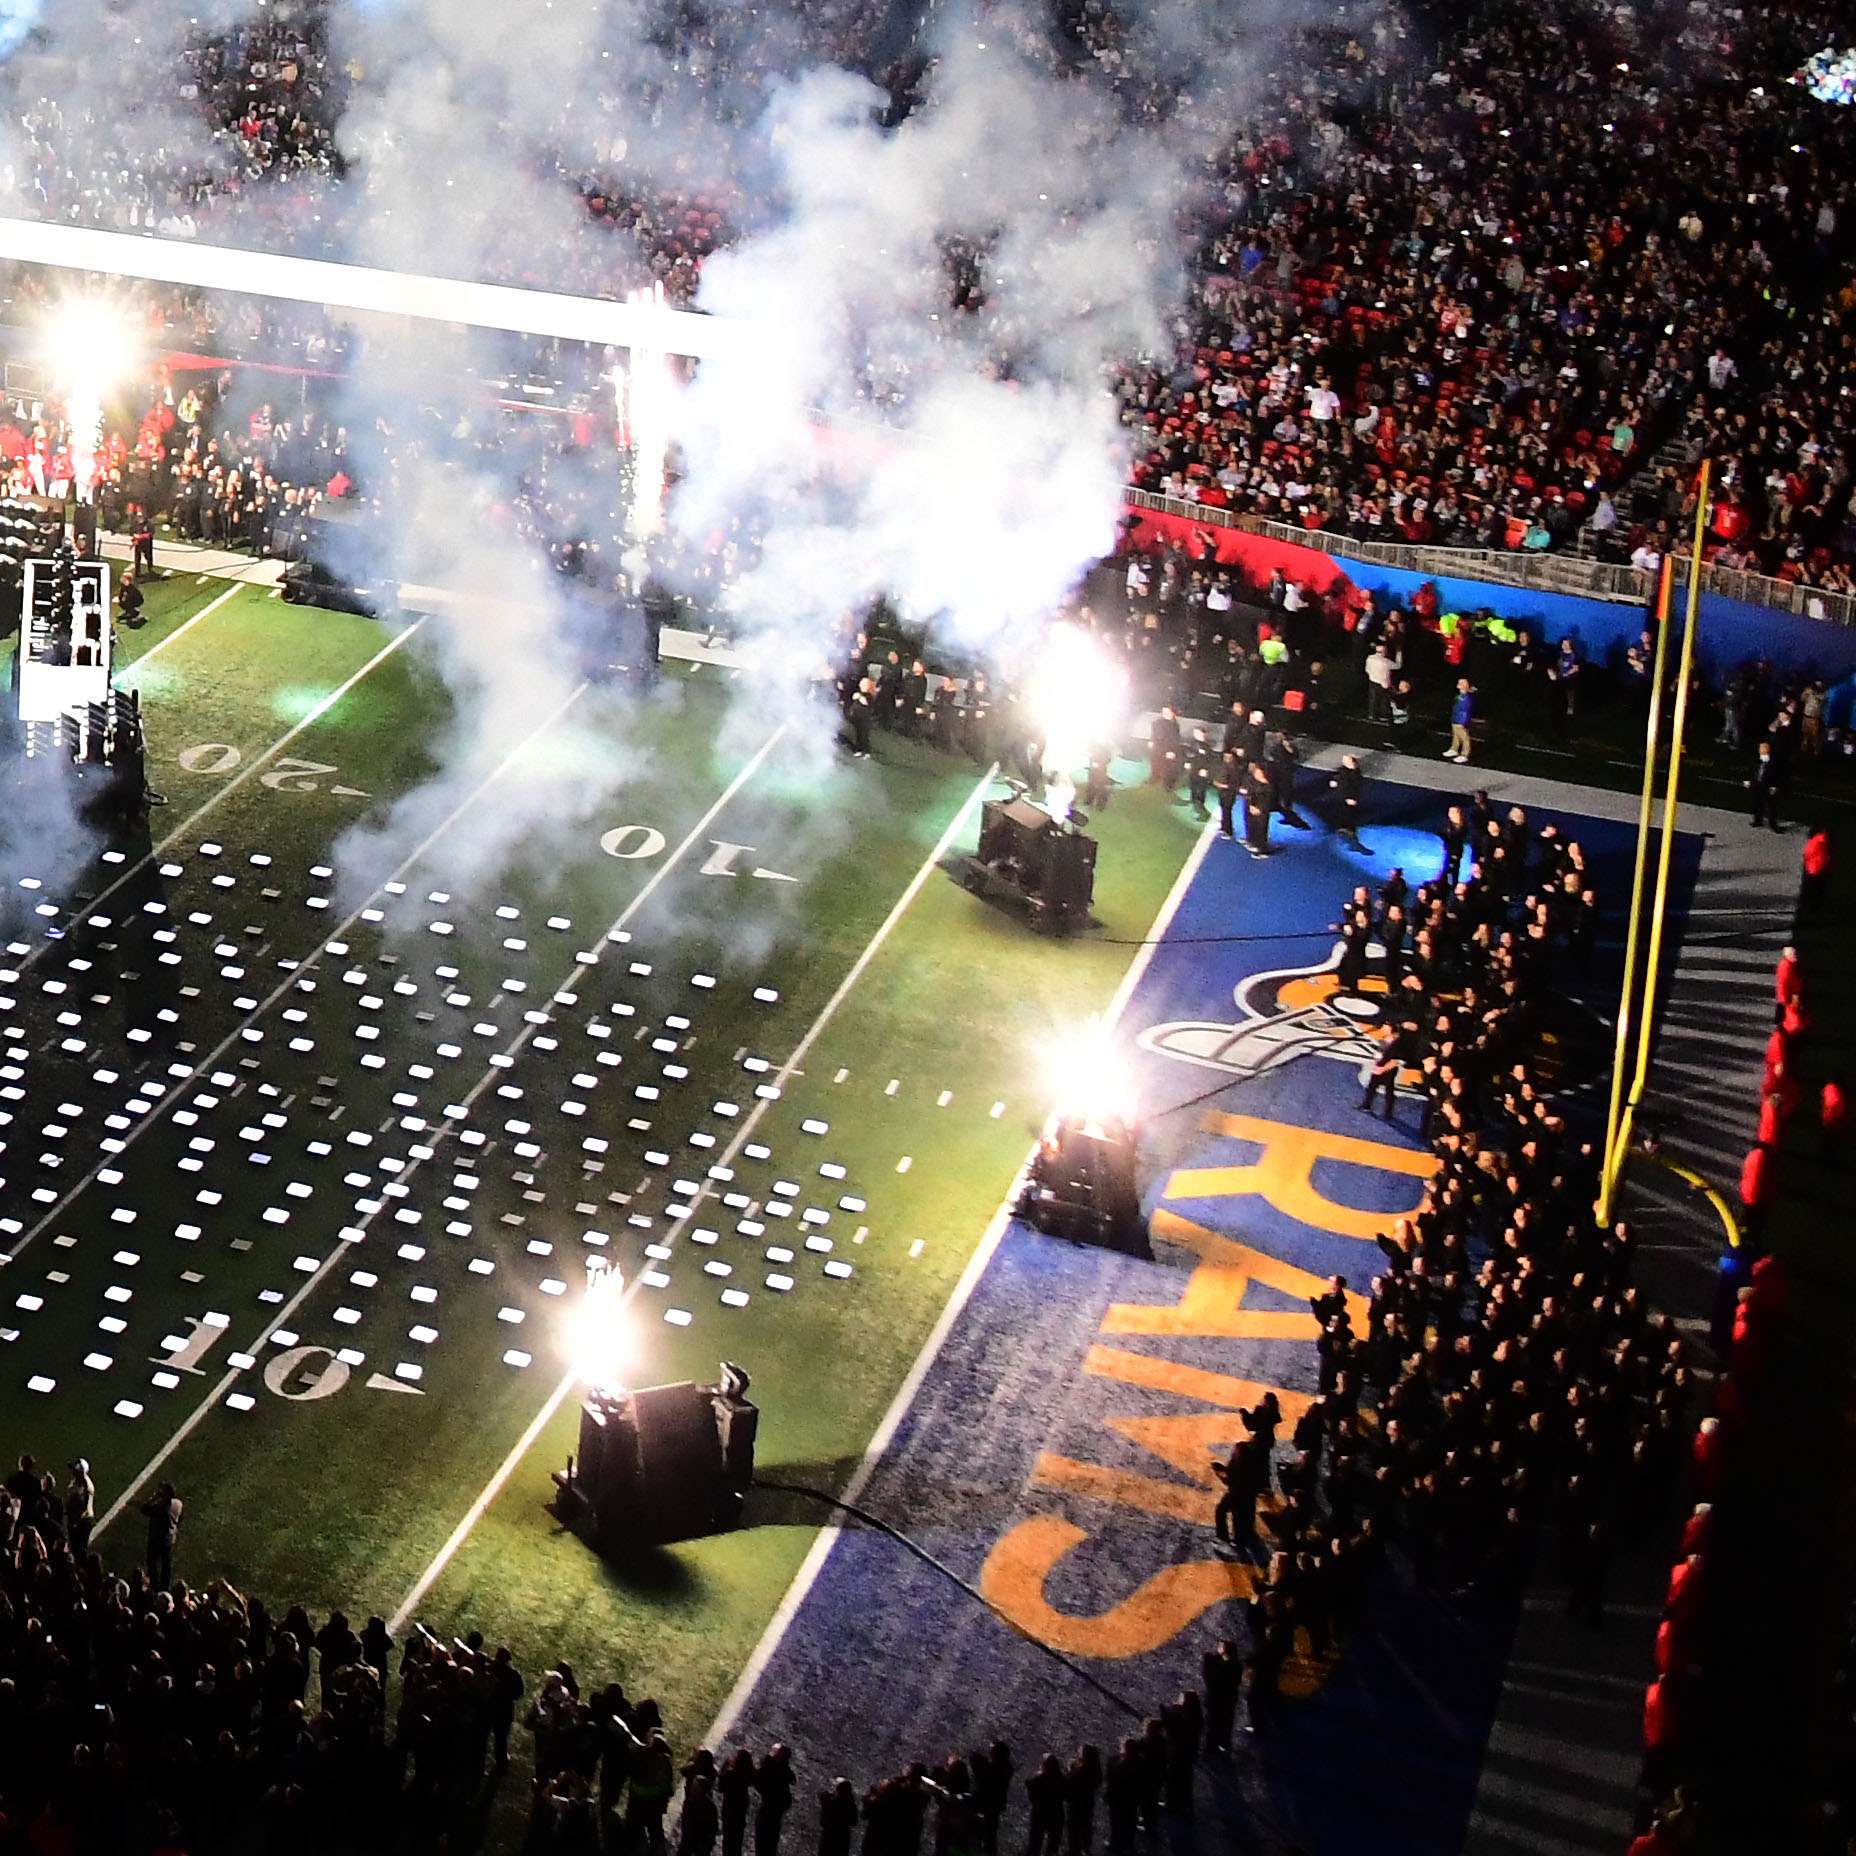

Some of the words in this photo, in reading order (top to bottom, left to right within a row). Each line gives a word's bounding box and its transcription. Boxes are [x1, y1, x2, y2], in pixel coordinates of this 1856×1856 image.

[178, 742, 339, 793] 20
[599, 825, 758, 877] 10
[148, 1316, 351, 1401] 10
[979, 1109, 1446, 1697] RAMS
